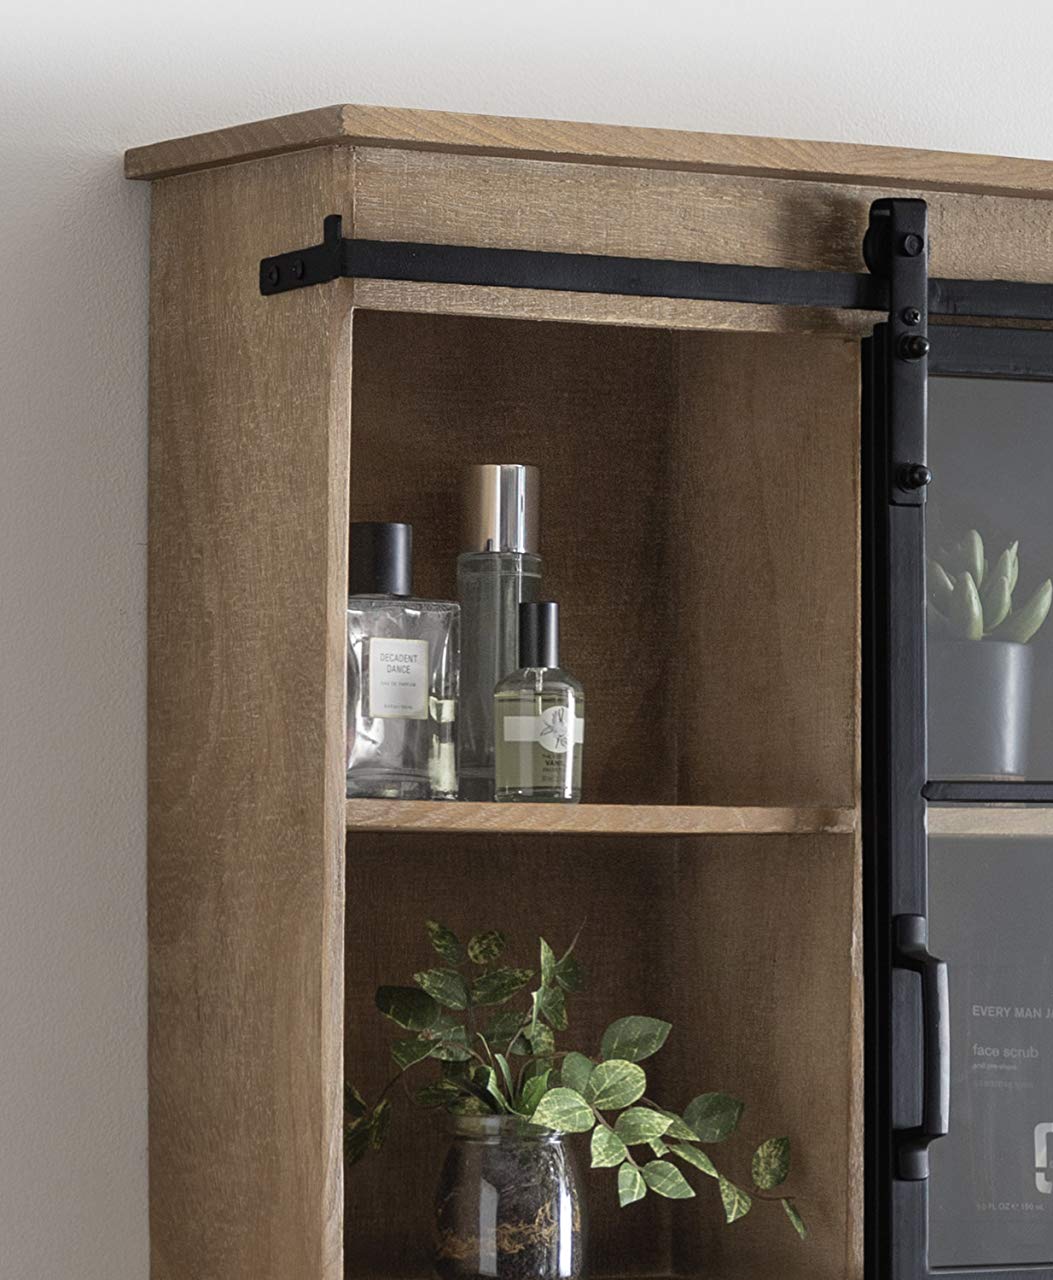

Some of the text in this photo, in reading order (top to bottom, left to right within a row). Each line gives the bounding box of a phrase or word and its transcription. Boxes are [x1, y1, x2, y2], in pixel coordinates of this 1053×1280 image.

[380, 653, 417, 663] DECADENT
[387, 664, 411, 674] DANCE
[972, 1004, 1011, 1017] EVERY
[1014, 1006, 1042, 1018] MAN
[972, 1043, 1039, 1058] face scrub
